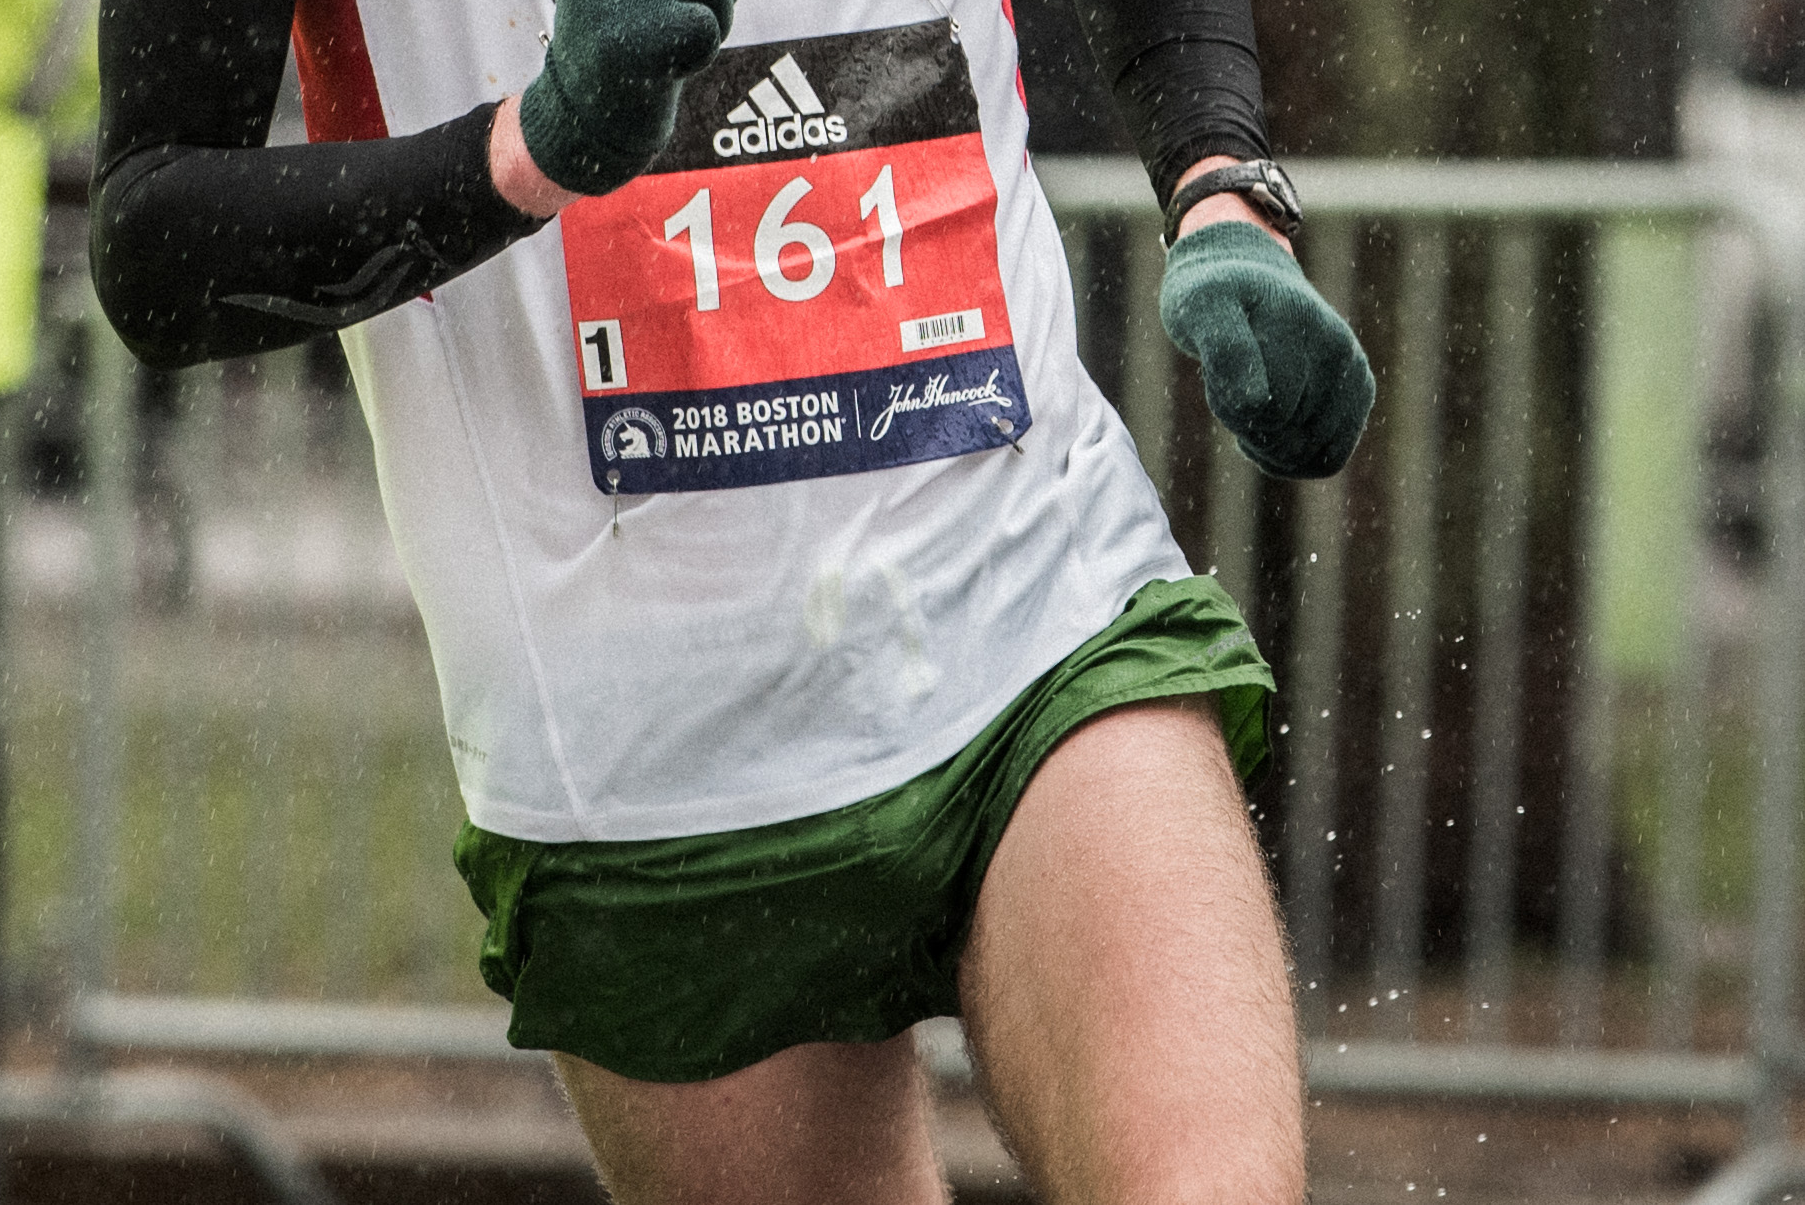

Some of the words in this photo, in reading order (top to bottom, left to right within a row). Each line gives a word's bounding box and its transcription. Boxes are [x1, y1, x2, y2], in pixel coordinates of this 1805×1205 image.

[713, 113, 848, 157] adidas
[664, 164, 904, 312] 161
[584, 326, 614, 383] 1
[672, 404, 728, 430] 2018
[736, 391, 840, 425] BOSTON
[870, 383, 922, 441] John
[920, 368, 1012, 409] Hancock
[674, 417, 843, 458] MARATHON
